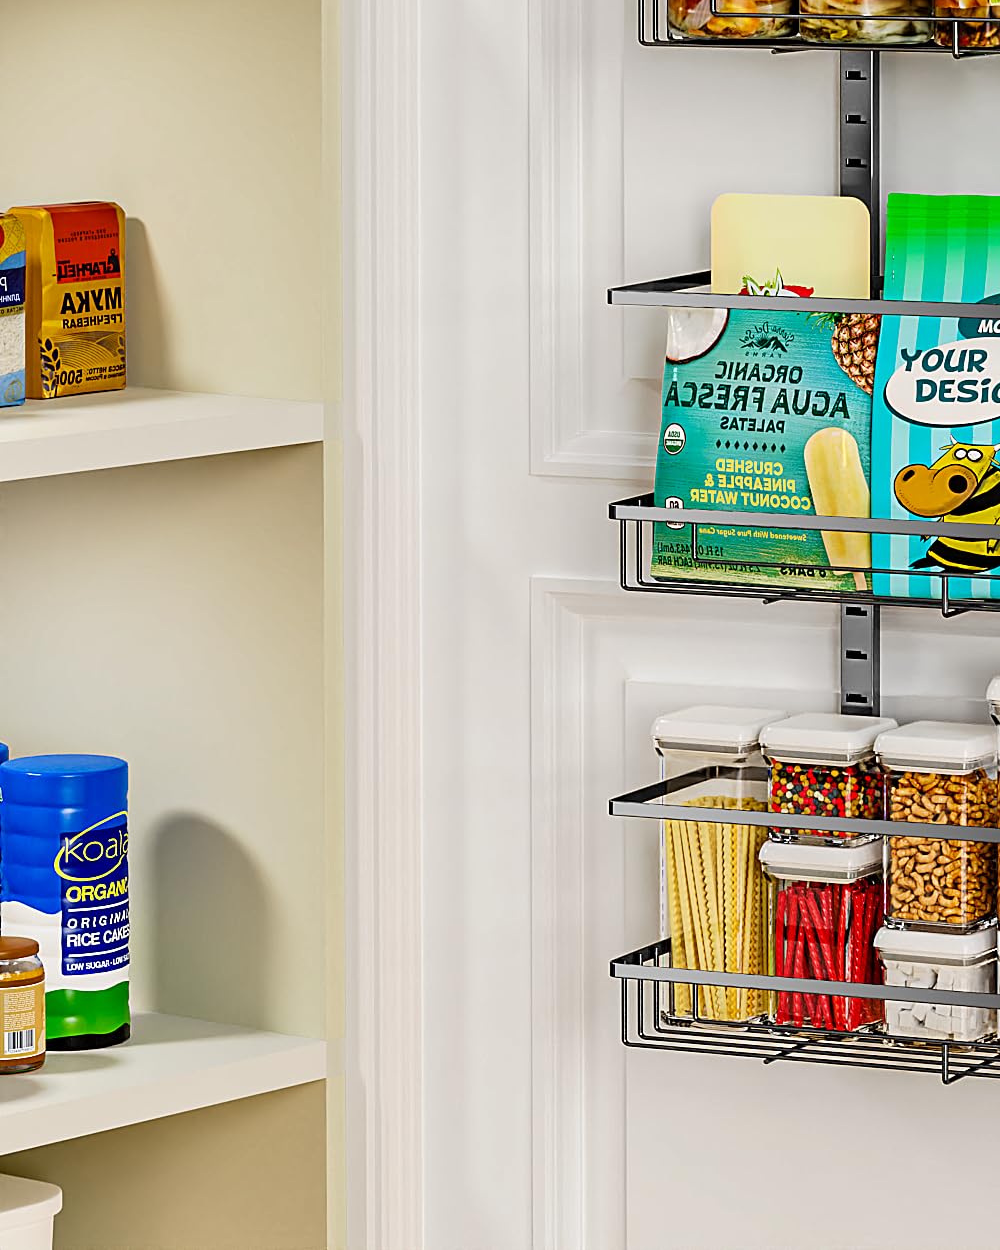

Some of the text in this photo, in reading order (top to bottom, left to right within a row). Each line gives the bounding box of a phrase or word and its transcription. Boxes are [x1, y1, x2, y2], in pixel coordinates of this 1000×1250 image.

[900, 347, 988, 373] YOUR
[66, 932, 101, 948] RICE
[66, 962, 85, 971] LOW
[85, 959, 110, 970] SUGAR
